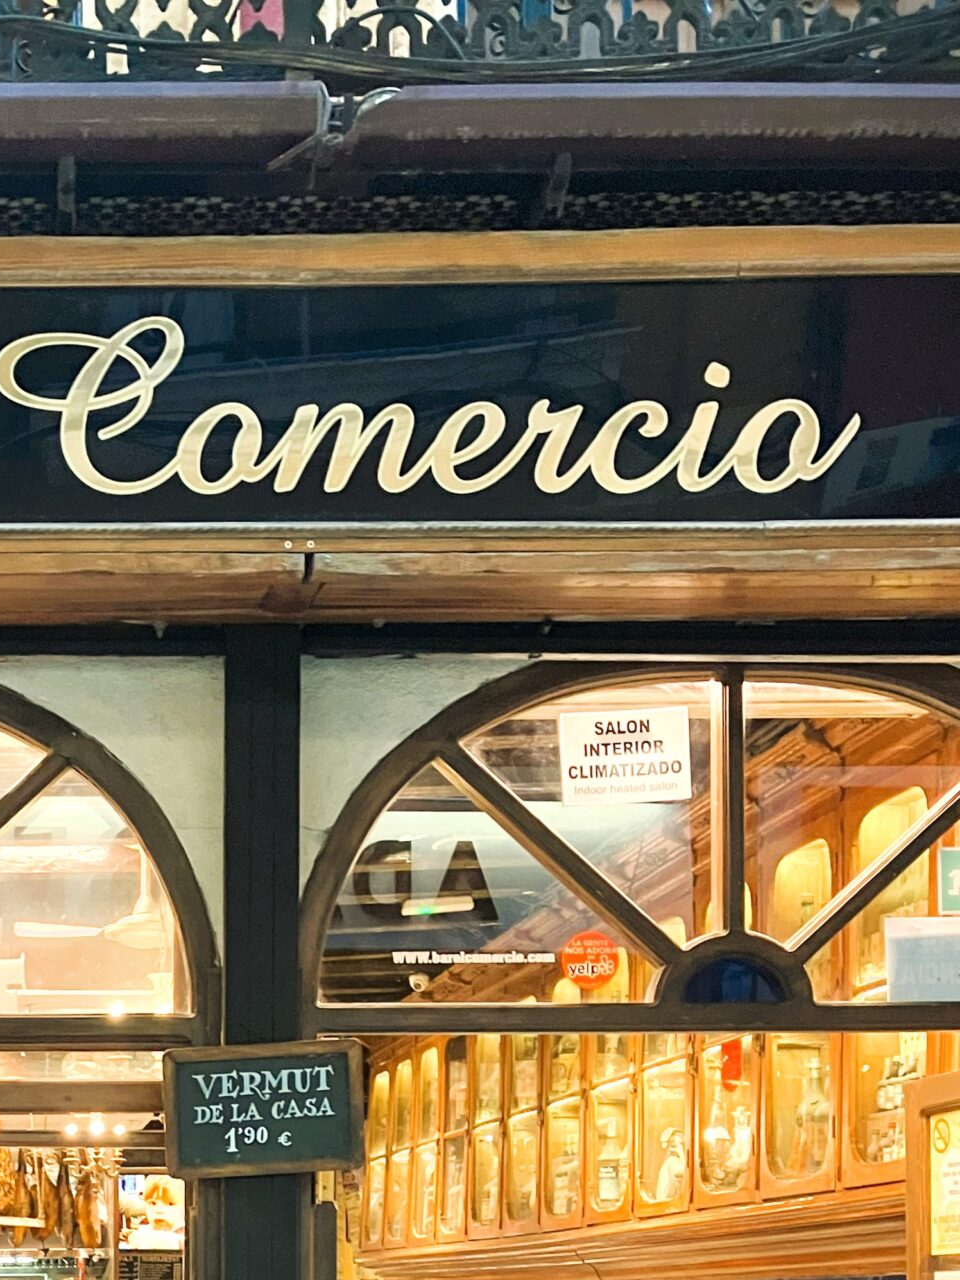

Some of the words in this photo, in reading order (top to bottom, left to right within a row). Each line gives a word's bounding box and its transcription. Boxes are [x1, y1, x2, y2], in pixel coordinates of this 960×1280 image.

[594, 719, 651, 736] SALON
[583, 740, 665, 757] INTERIOR
[568, 760, 683, 780] CLIMATIZADO
[574, 784, 607, 796] Indoor
[609, 782, 647, 795] heated
[649, 780, 678, 793] salon
[569, 963, 599, 976] yelp
[192, 1064, 335, 1101] VERMUT
[194, 1103, 224, 1125] DE
[230, 1102, 263, 1123] LA
[271, 1097, 336, 1120] CASA
[277, 1131, 292, 1147] €
